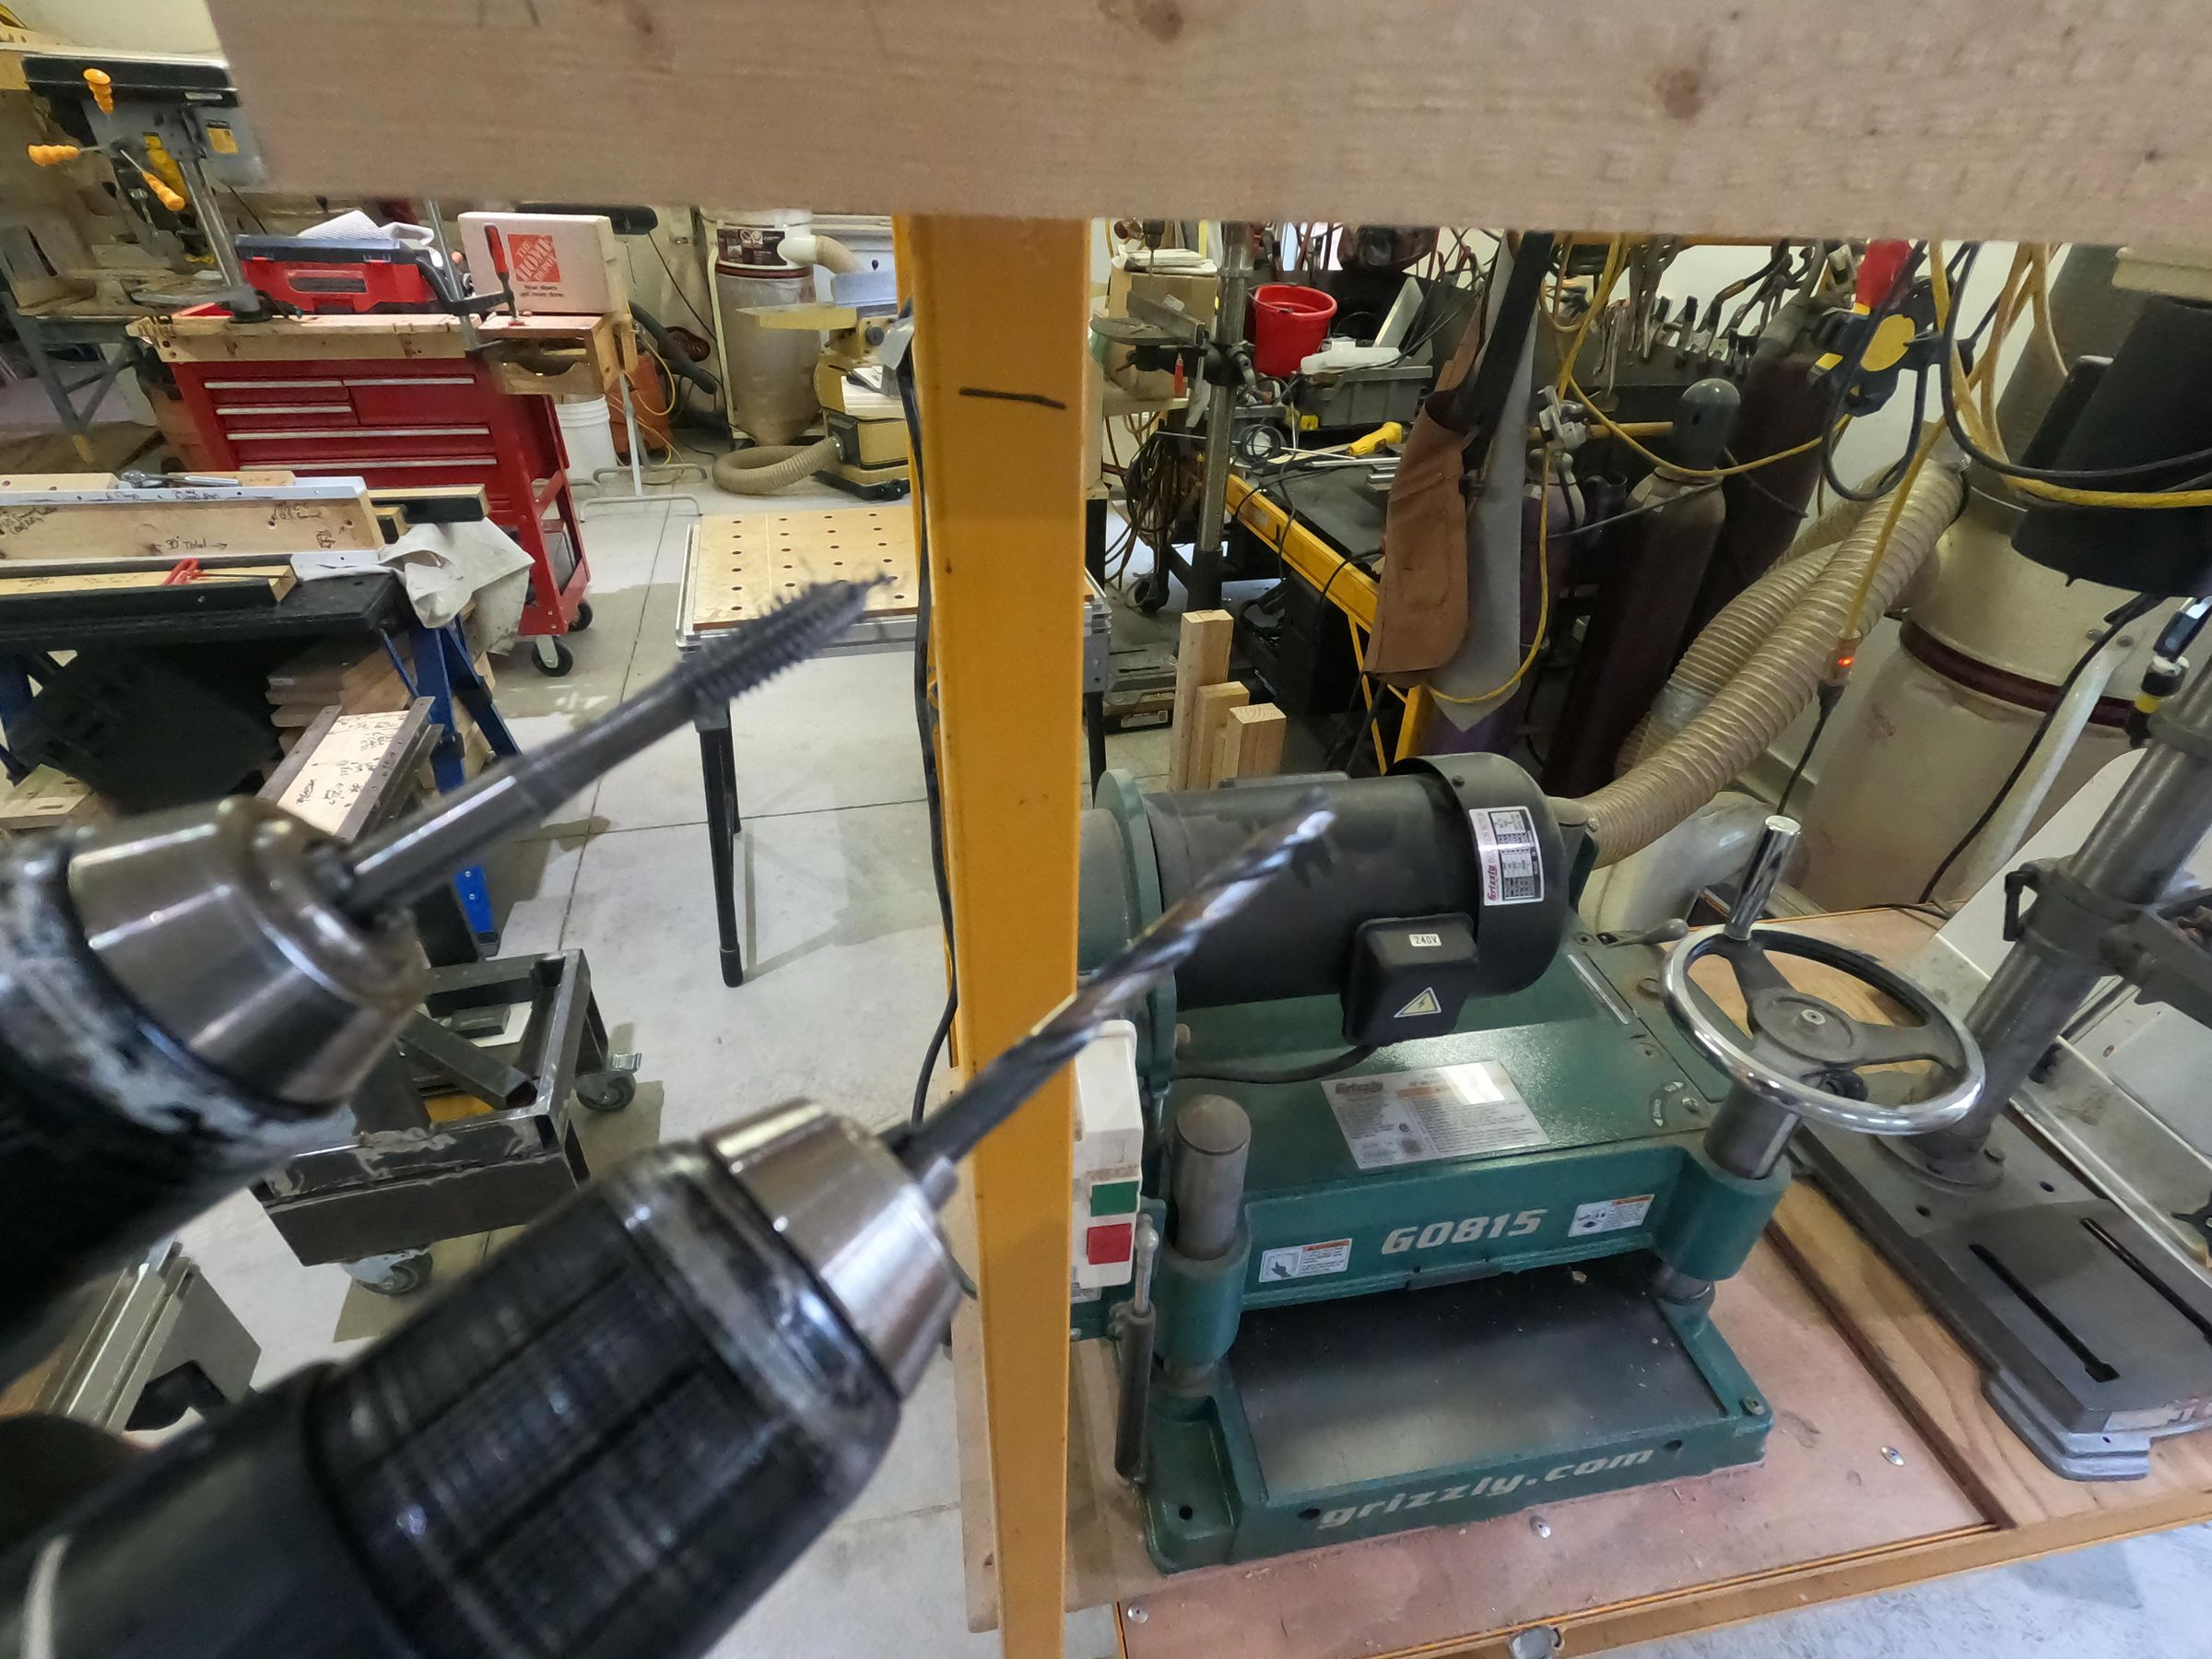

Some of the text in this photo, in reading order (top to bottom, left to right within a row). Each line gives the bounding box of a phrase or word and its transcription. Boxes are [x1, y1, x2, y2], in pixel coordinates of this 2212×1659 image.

[516, 240, 533, 258] THE
[516, 237, 554, 281] HOME
[1414, 935, 1438, 945] 240V
[1317, 1449, 1654, 1530] grizzly.com
